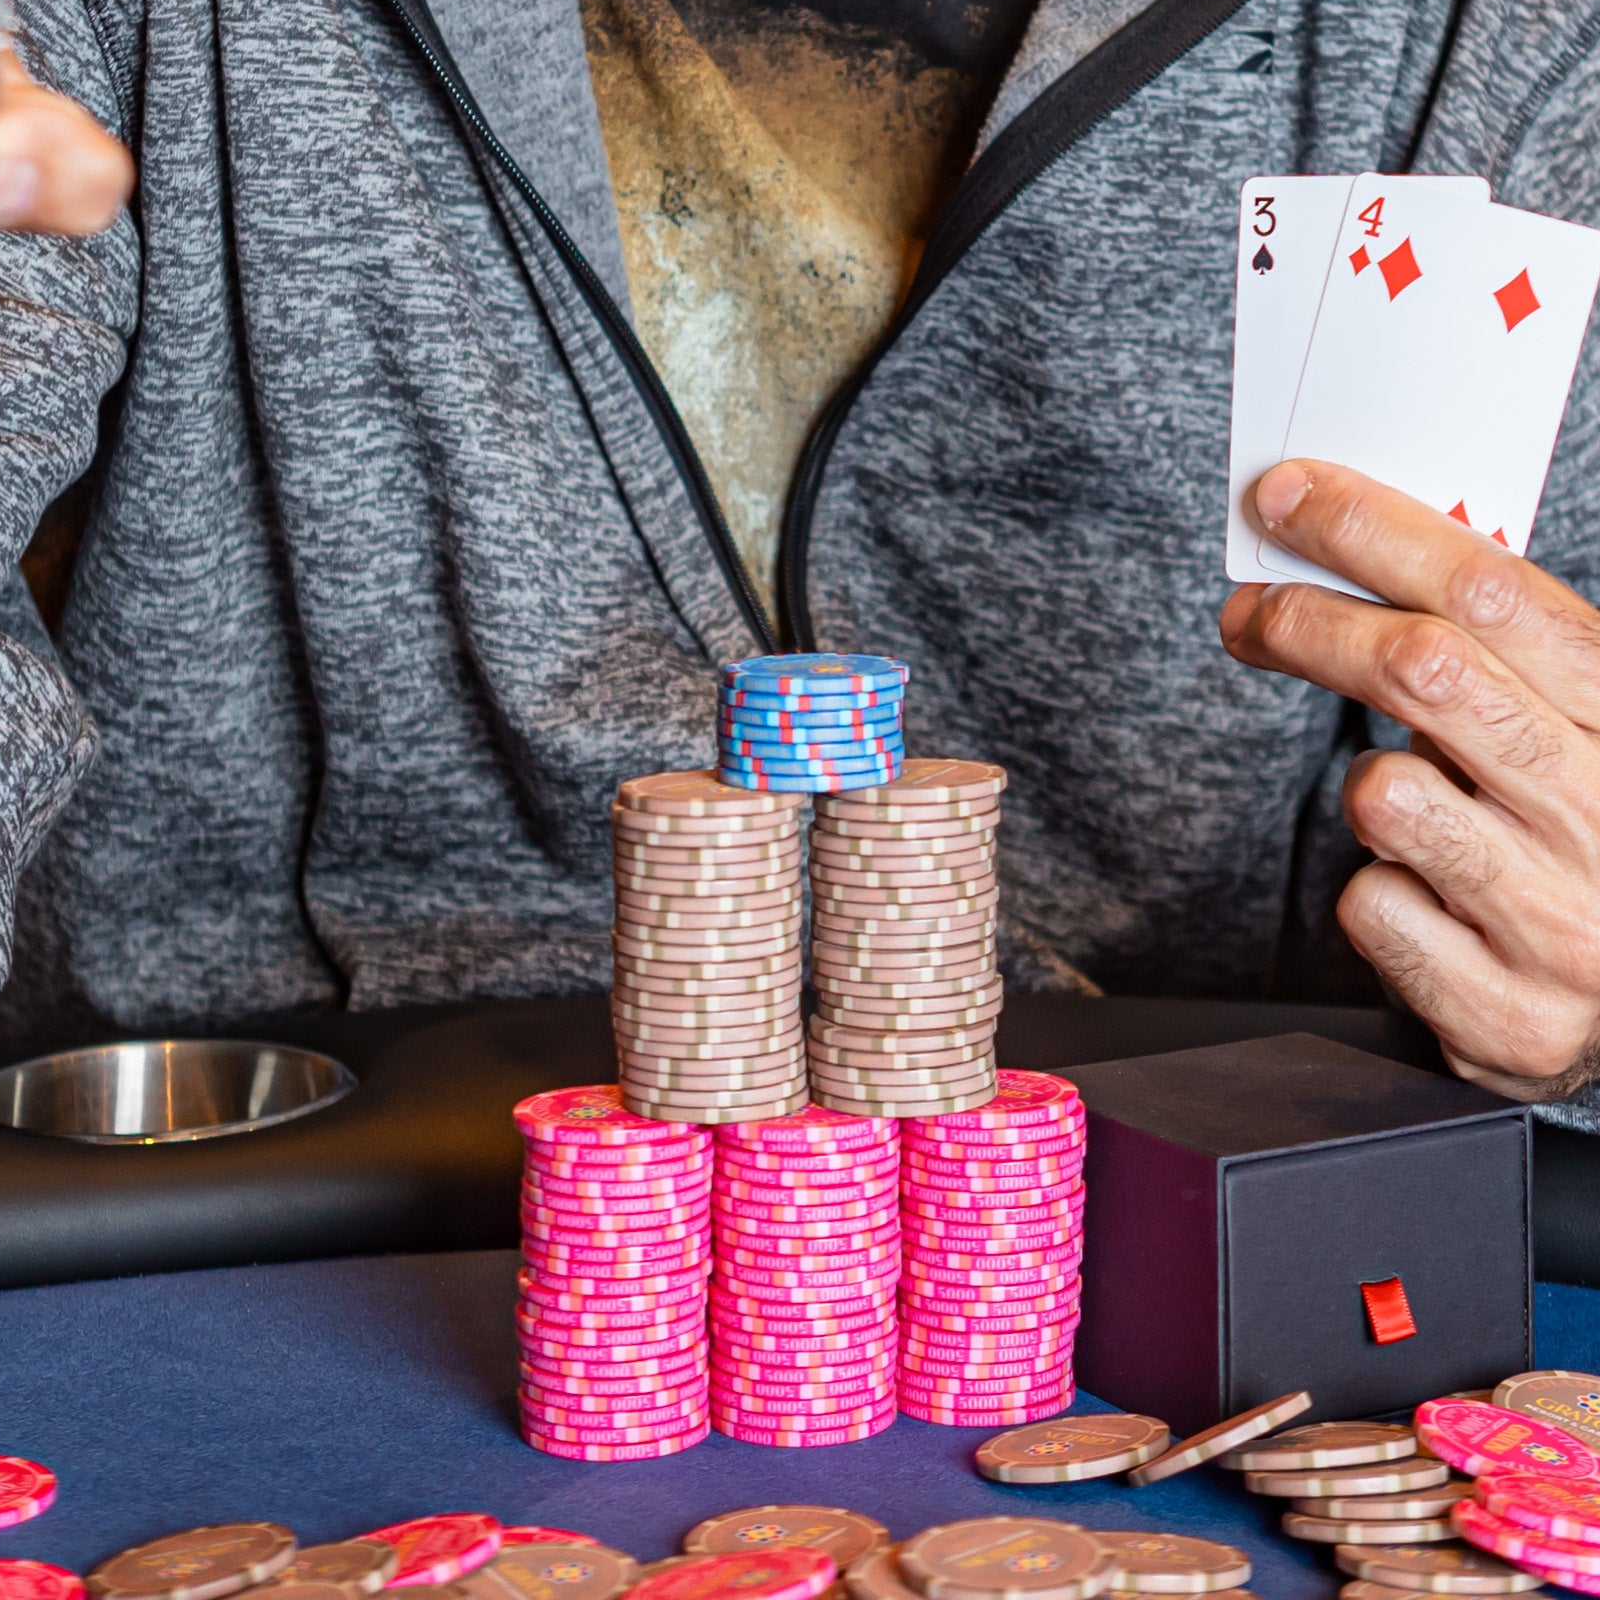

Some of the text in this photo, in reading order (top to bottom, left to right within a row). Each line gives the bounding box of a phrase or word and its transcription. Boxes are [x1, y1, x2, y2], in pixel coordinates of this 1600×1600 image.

[1253, 197, 1276, 236] 3
[1358, 197, 1385, 237] 4
[1524, 1403, 1570, 1424] RESORT
